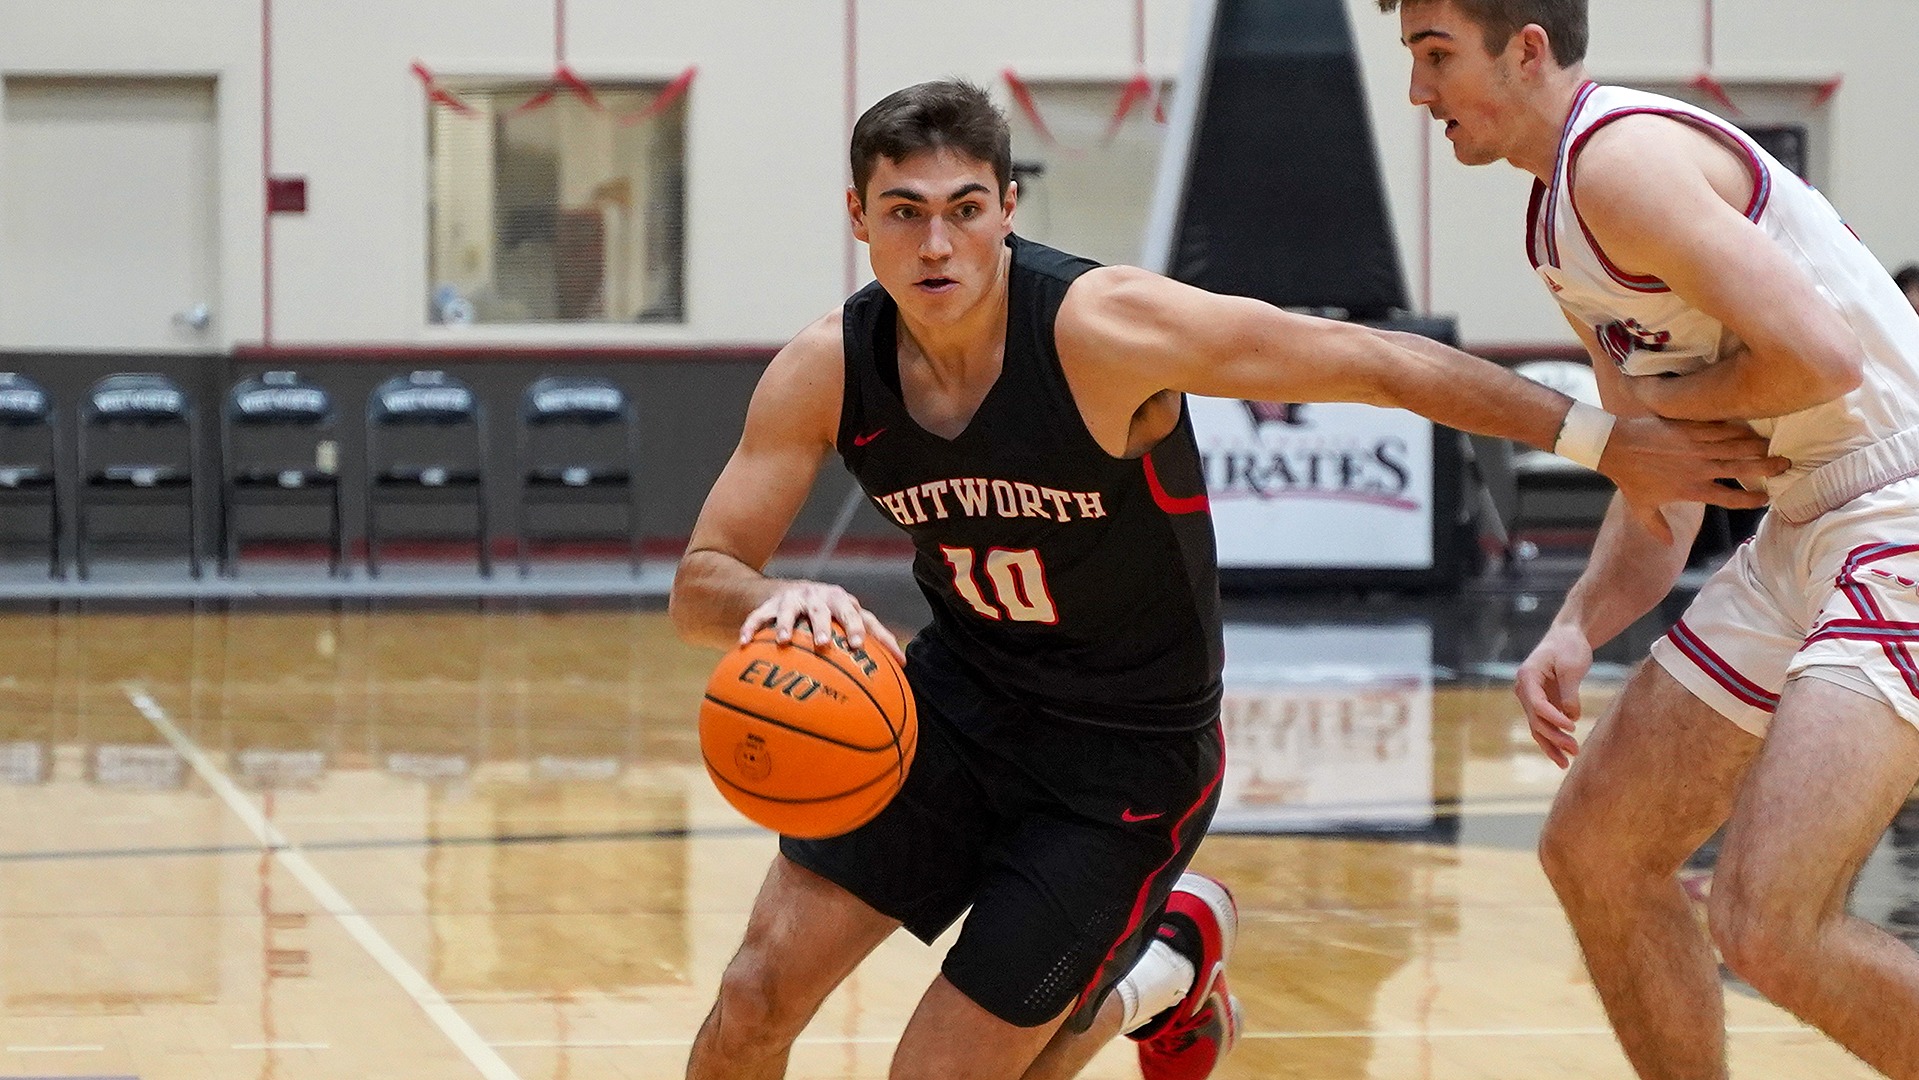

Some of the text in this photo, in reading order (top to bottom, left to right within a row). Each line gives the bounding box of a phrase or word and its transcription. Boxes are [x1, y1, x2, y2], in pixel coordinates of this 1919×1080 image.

[1201, 436, 1411, 498] IRATES
[873, 478, 1107, 525] HITWORTH
[939, 544, 1059, 625] 10
[738, 658, 821, 701] EVO
